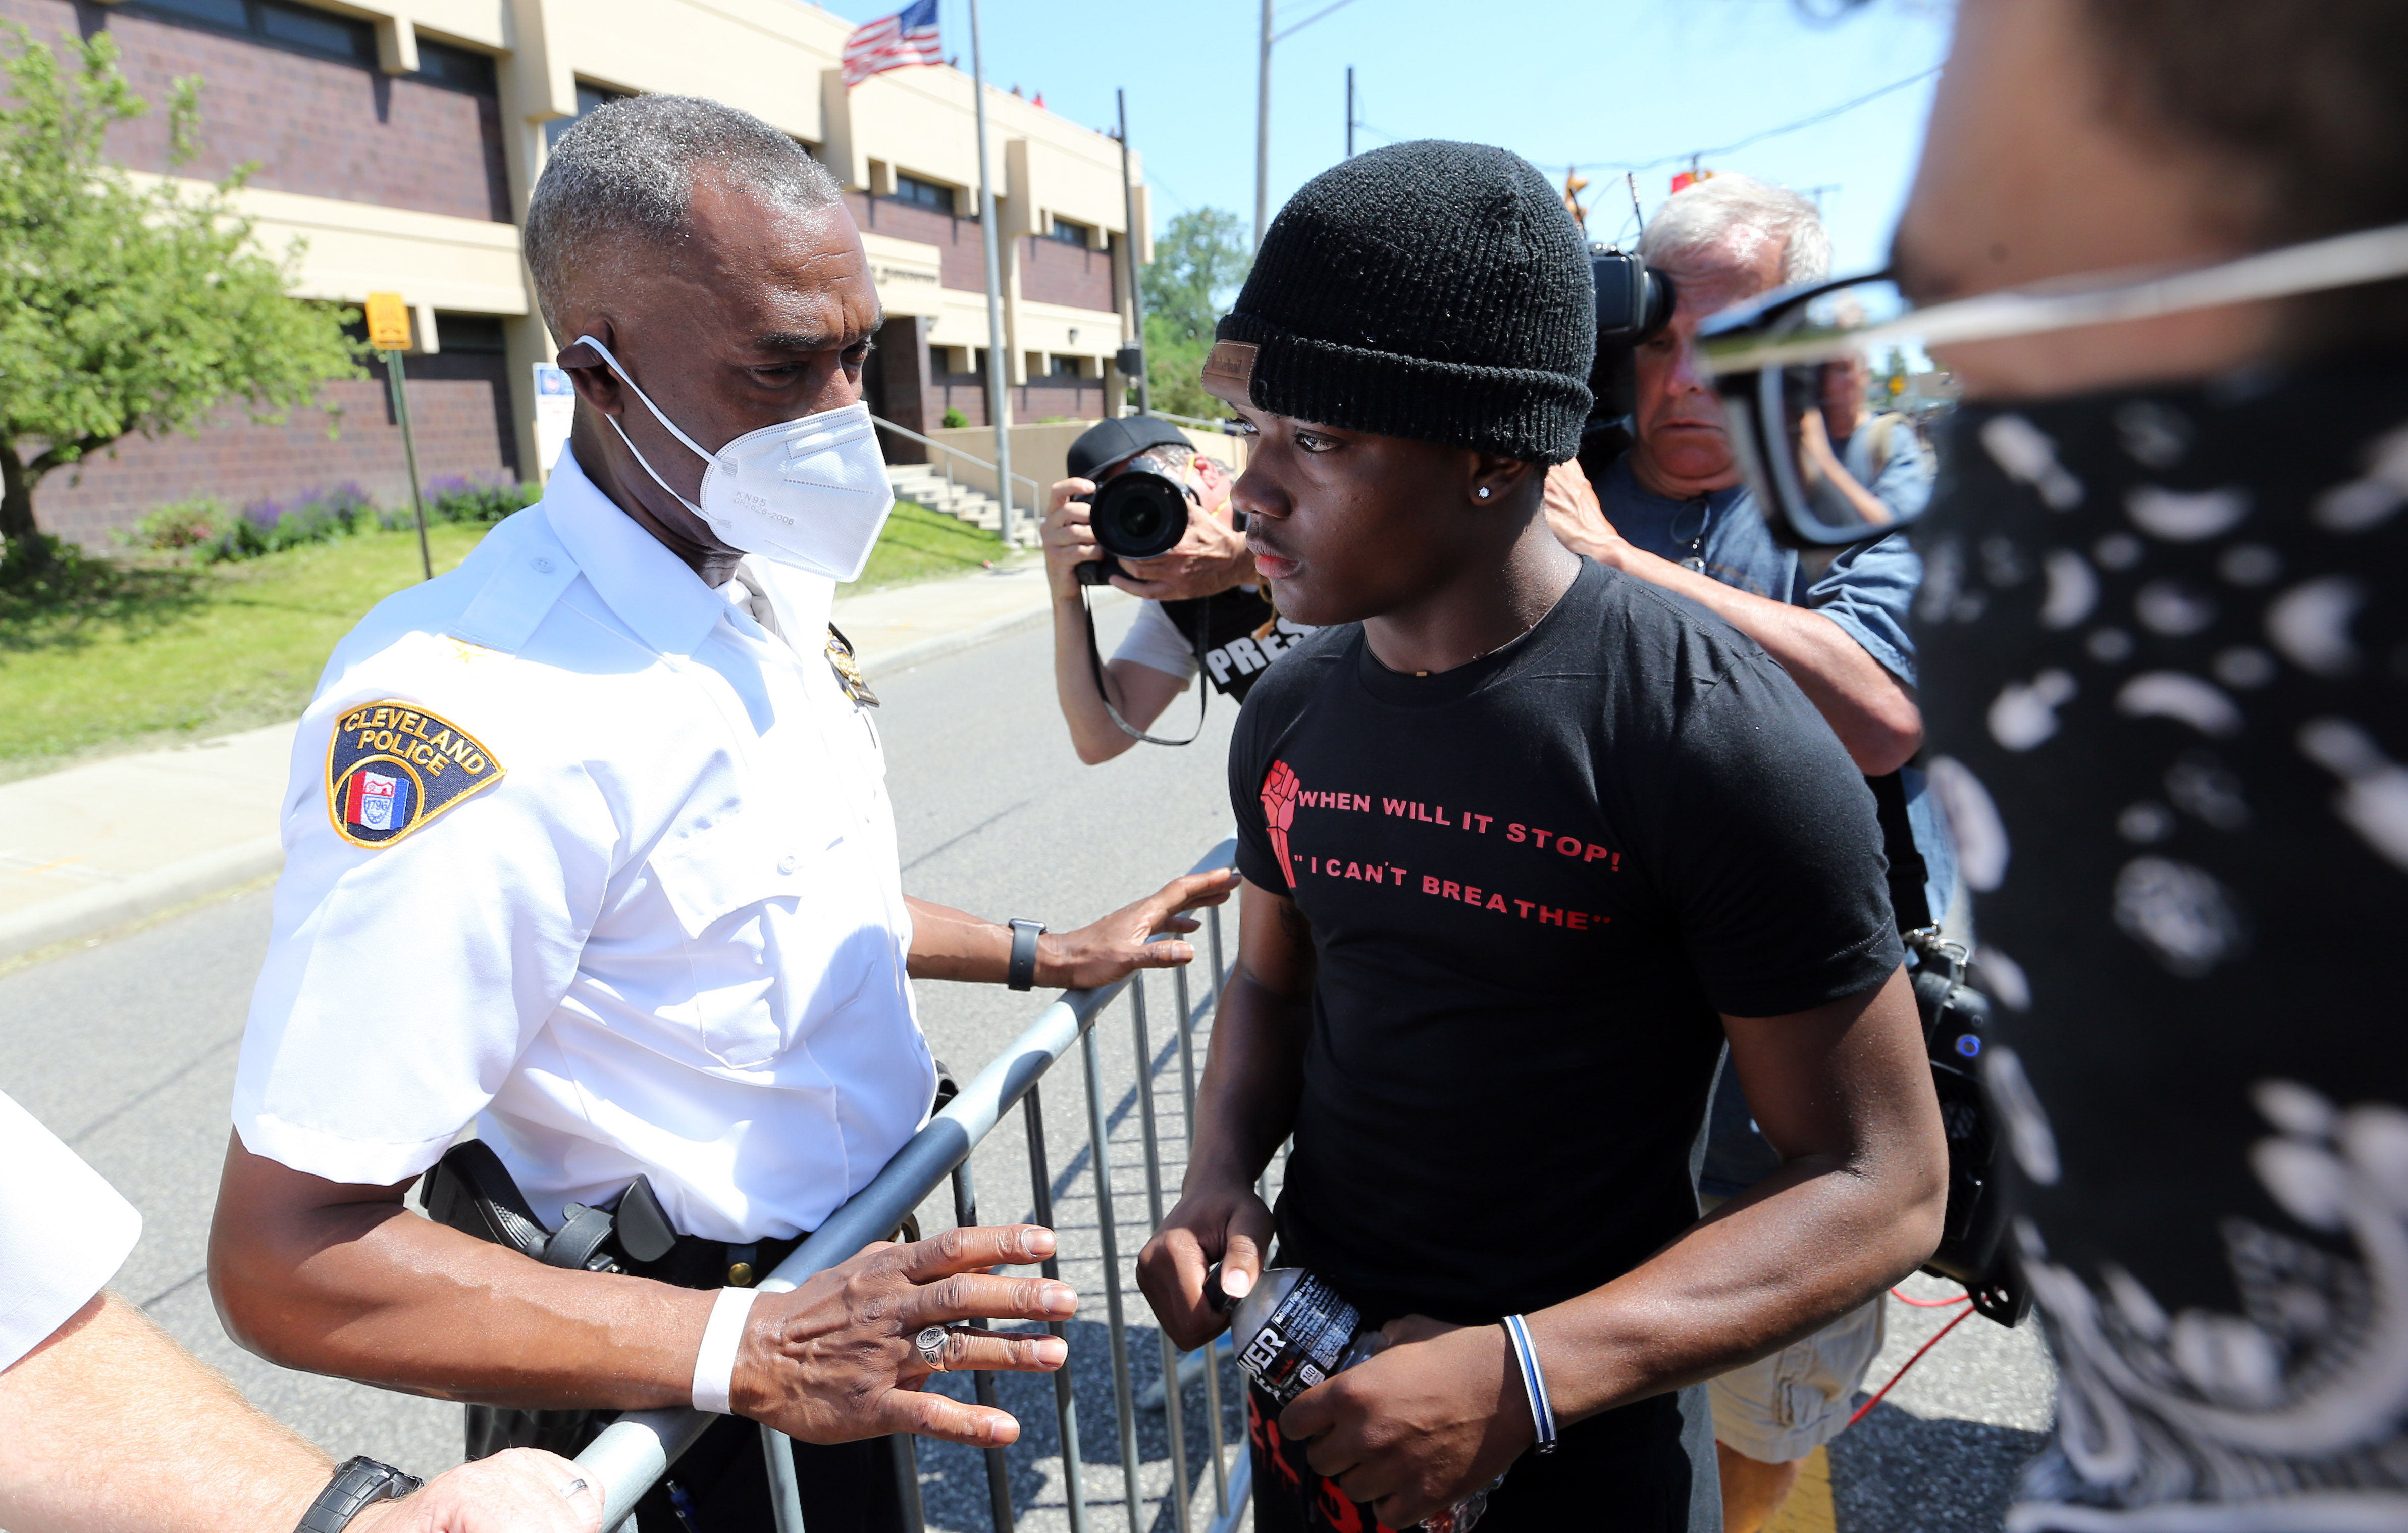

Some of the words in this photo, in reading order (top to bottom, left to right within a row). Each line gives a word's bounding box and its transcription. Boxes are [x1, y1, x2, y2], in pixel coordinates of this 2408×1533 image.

[734, 497, 795, 526] GB2626-2006
[737, 490, 767, 507] KN95
[1206, 616, 1320, 685] PRES
[344, 708, 486, 775] CLEVELAND
[356, 730, 450, 777] POLICE
[1298, 791, 1370, 813] WHEN
[1382, 797, 1450, 826] WILL
[1462, 812, 1493, 834] IT
[1506, 822, 1621, 872] STOP!
[1326, 859, 1407, 886] CAN'T
[1422, 875, 1611, 931] BREATHE"
[1303, 1366, 1316, 1381] 140
